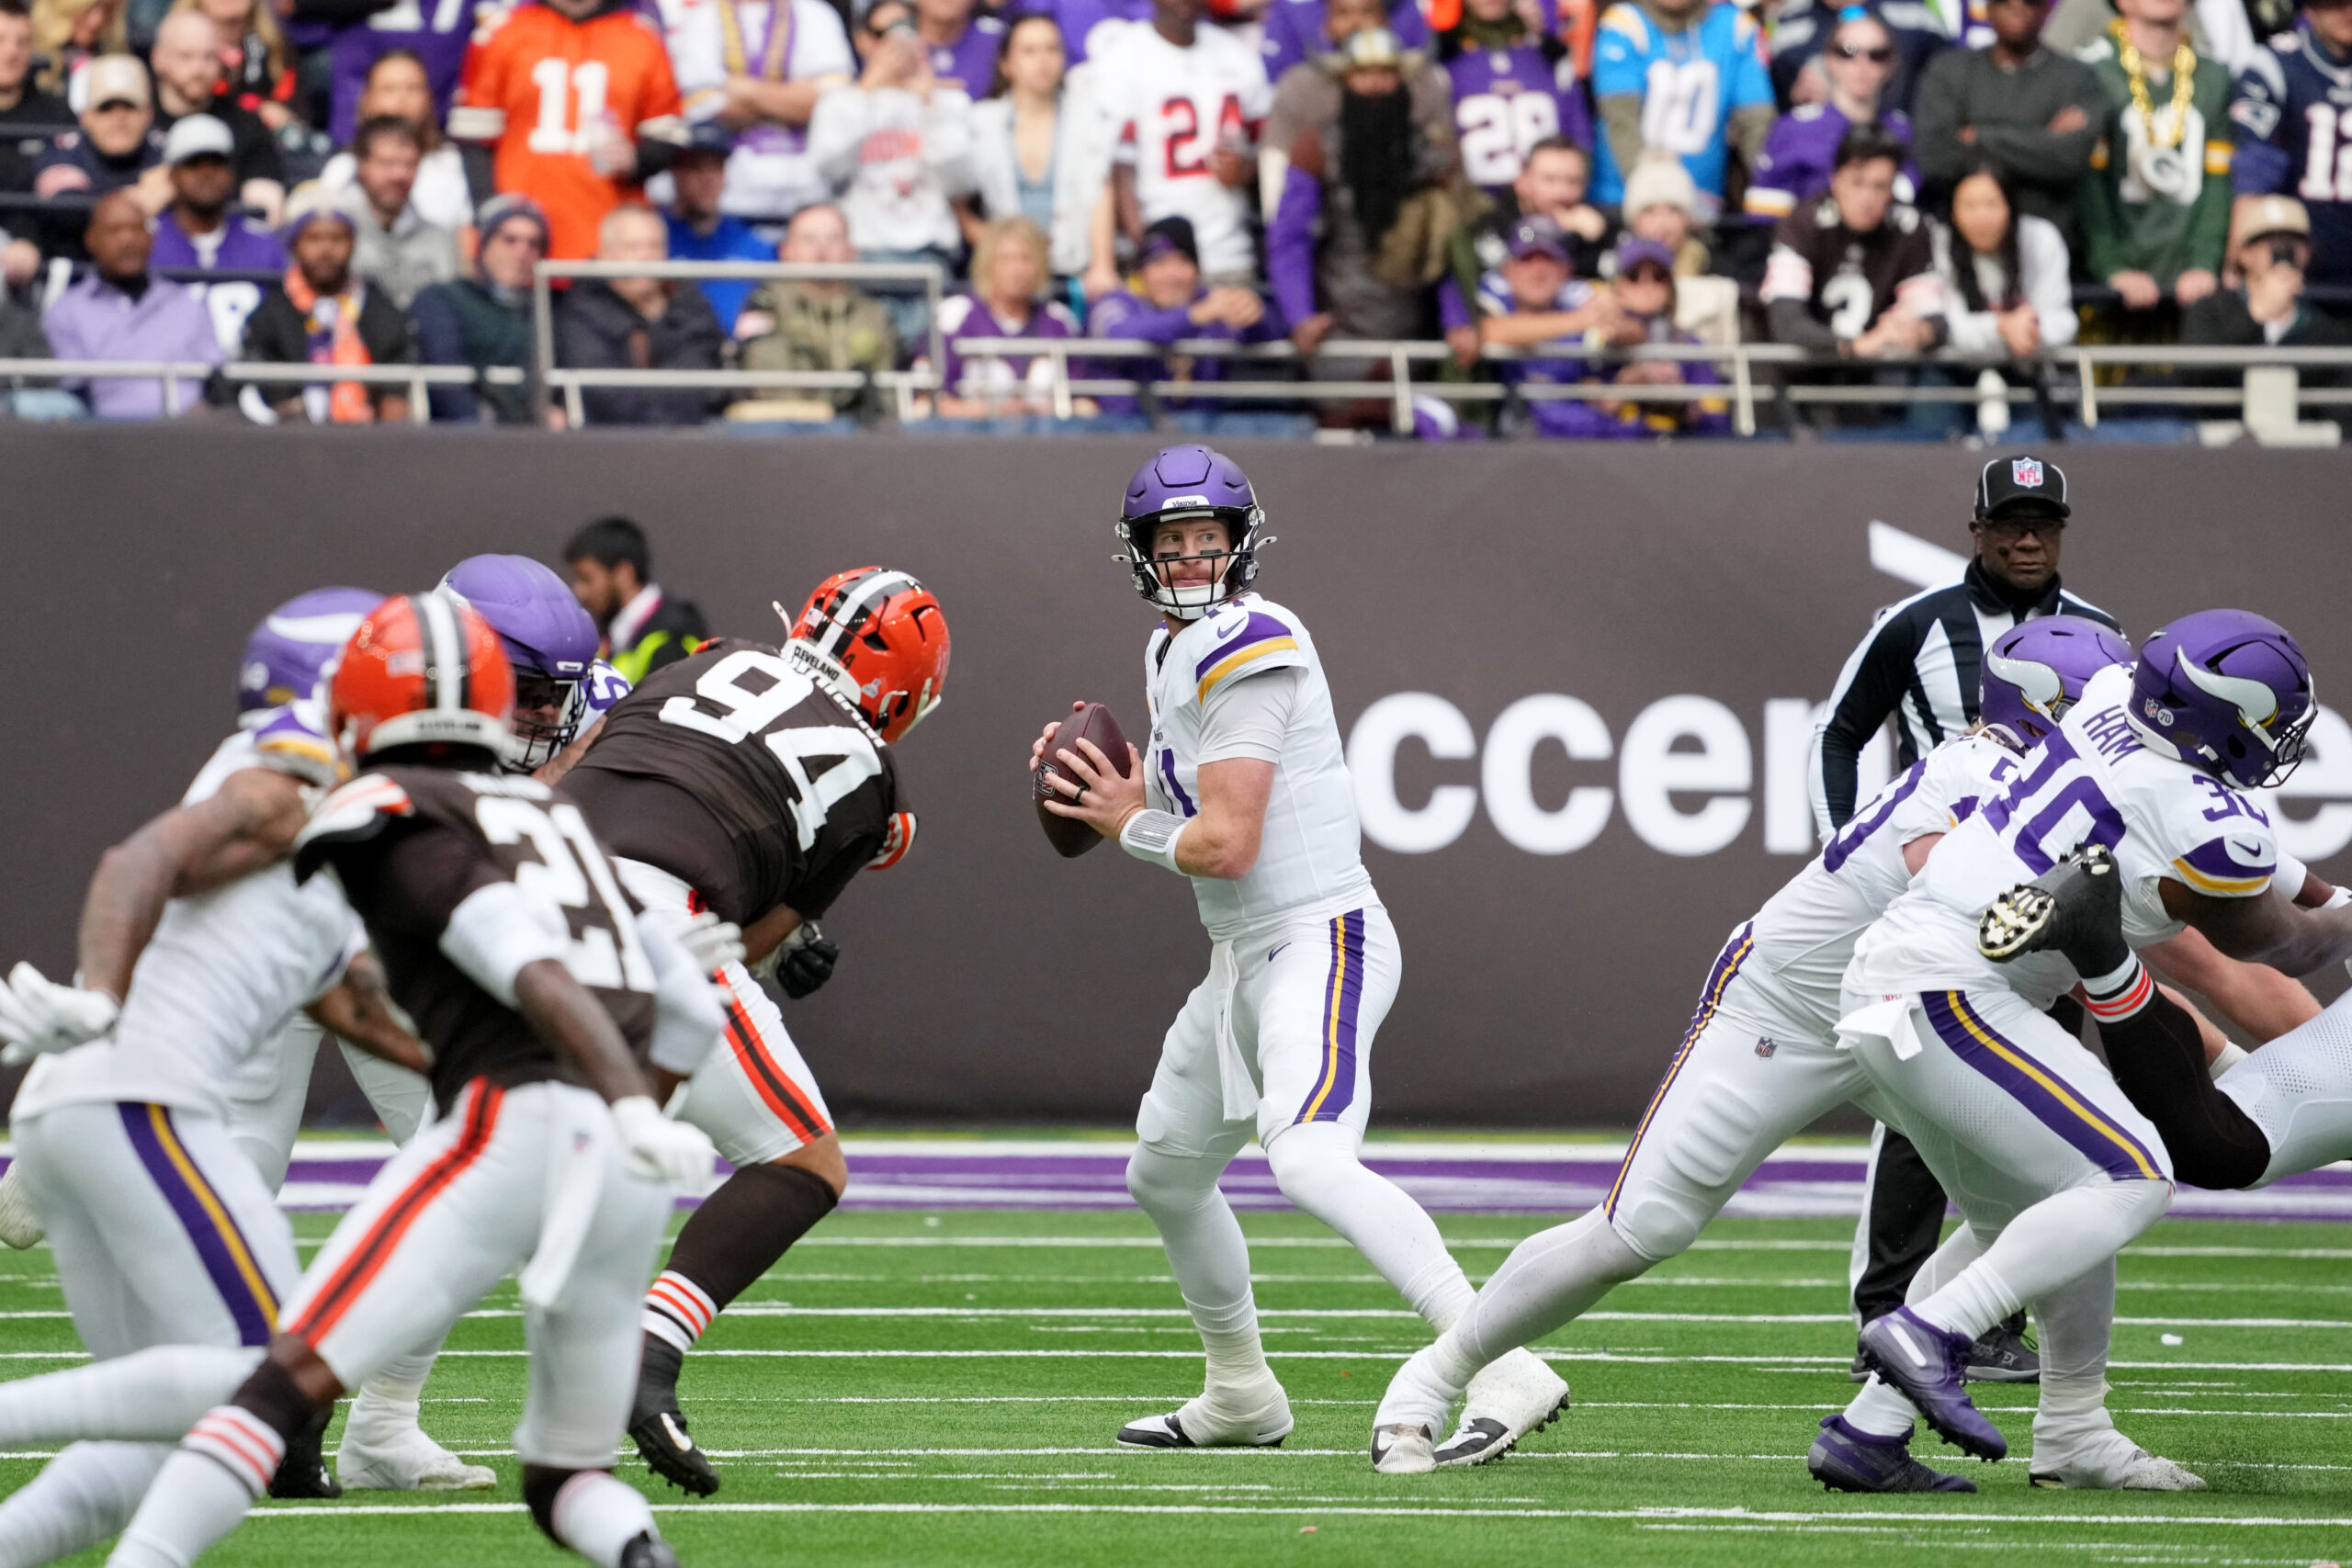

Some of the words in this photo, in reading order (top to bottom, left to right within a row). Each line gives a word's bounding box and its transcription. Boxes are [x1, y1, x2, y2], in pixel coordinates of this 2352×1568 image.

[527, 57, 608, 154] 11
[2017, 469, 2041, 483] NFL
[794, 647, 840, 681] CLEVELAND
[2082, 704, 2146, 767] HAM
[2159, 711, 2172, 725] 70
[659, 650, 882, 852] 94
[2192, 774, 2269, 829] 30
[474, 796, 660, 993] 21
[1757, 1042, 1773, 1058] NFL
